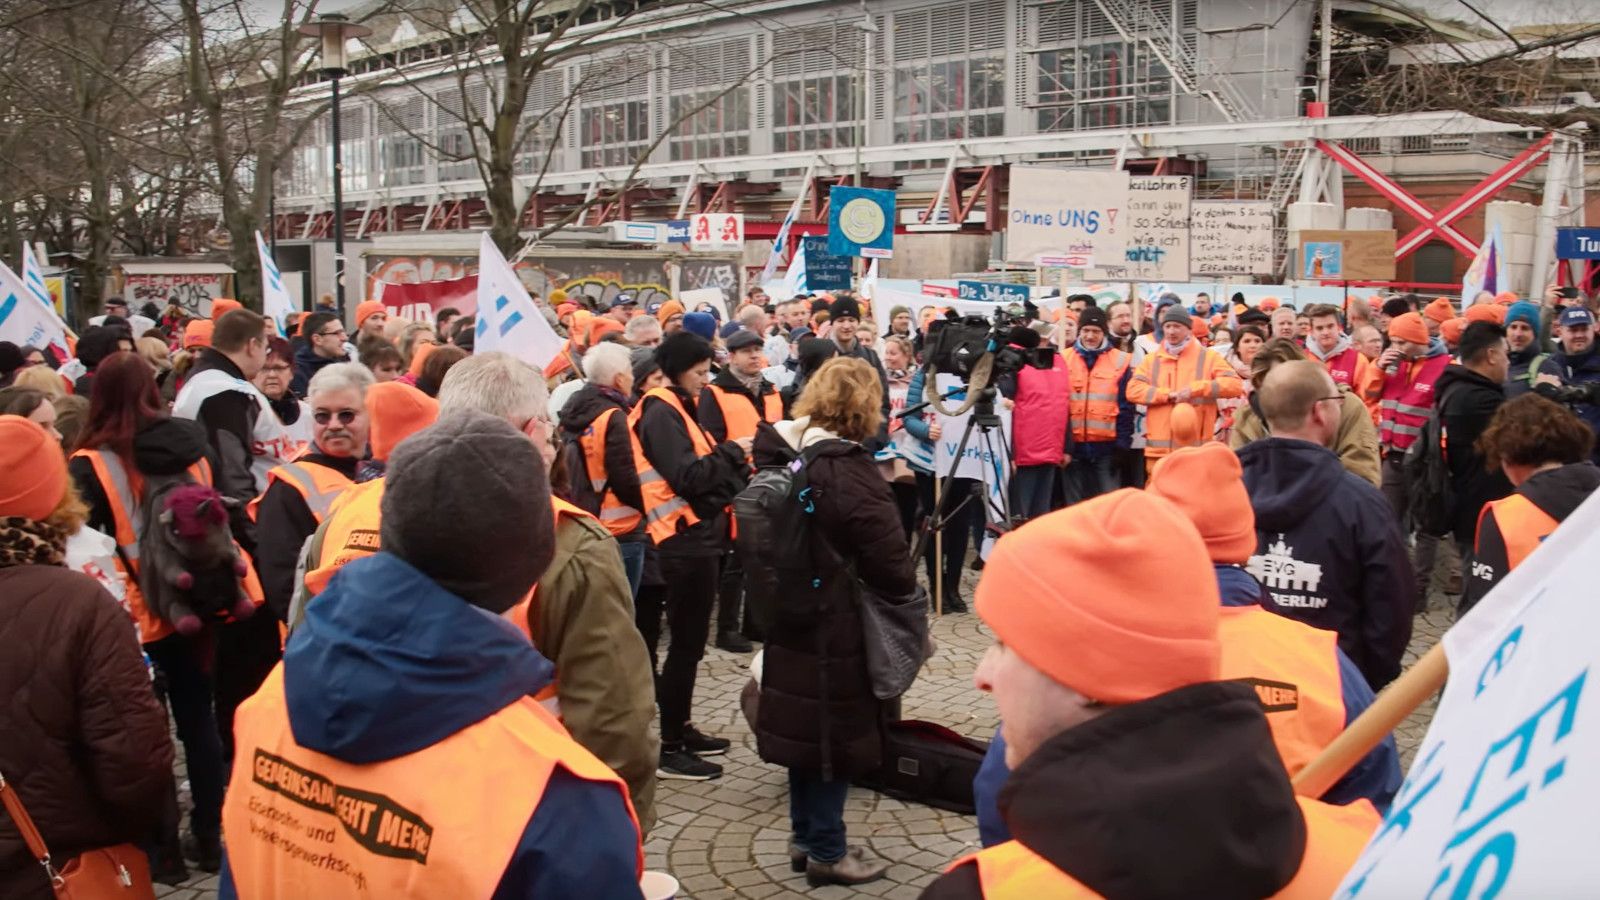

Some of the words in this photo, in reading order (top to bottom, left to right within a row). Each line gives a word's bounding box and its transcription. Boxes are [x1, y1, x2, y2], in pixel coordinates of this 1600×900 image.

[1012, 209, 1053, 226] Ohne
[1058, 210, 1100, 234] UNS
[1263, 559, 1296, 576] EVG
[254, 754, 337, 808] GEMEINSAM
[306, 825, 337, 844] und
